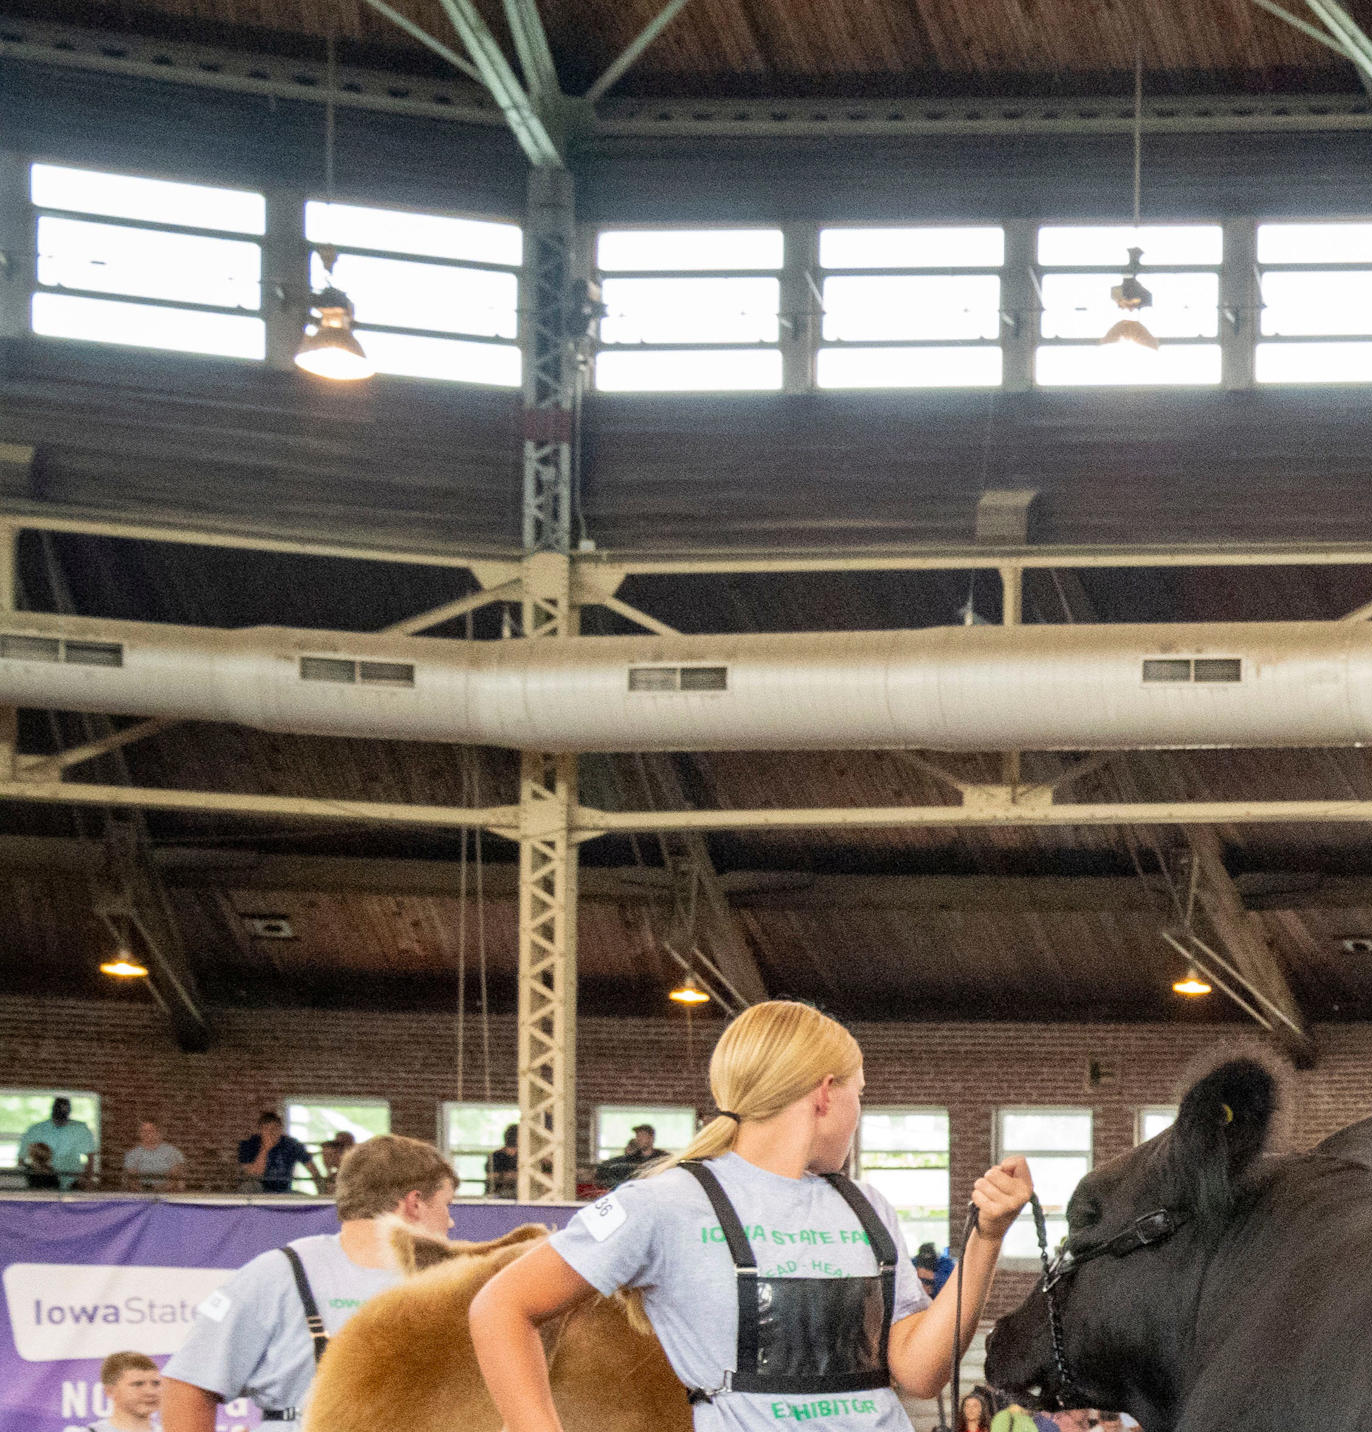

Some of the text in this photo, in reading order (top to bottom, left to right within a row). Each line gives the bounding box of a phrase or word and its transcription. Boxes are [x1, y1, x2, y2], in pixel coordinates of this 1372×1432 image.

[702, 1225, 767, 1244] IOA
[771, 1229, 835, 1246] STATE
[766, 1260, 797, 1278] EAD
